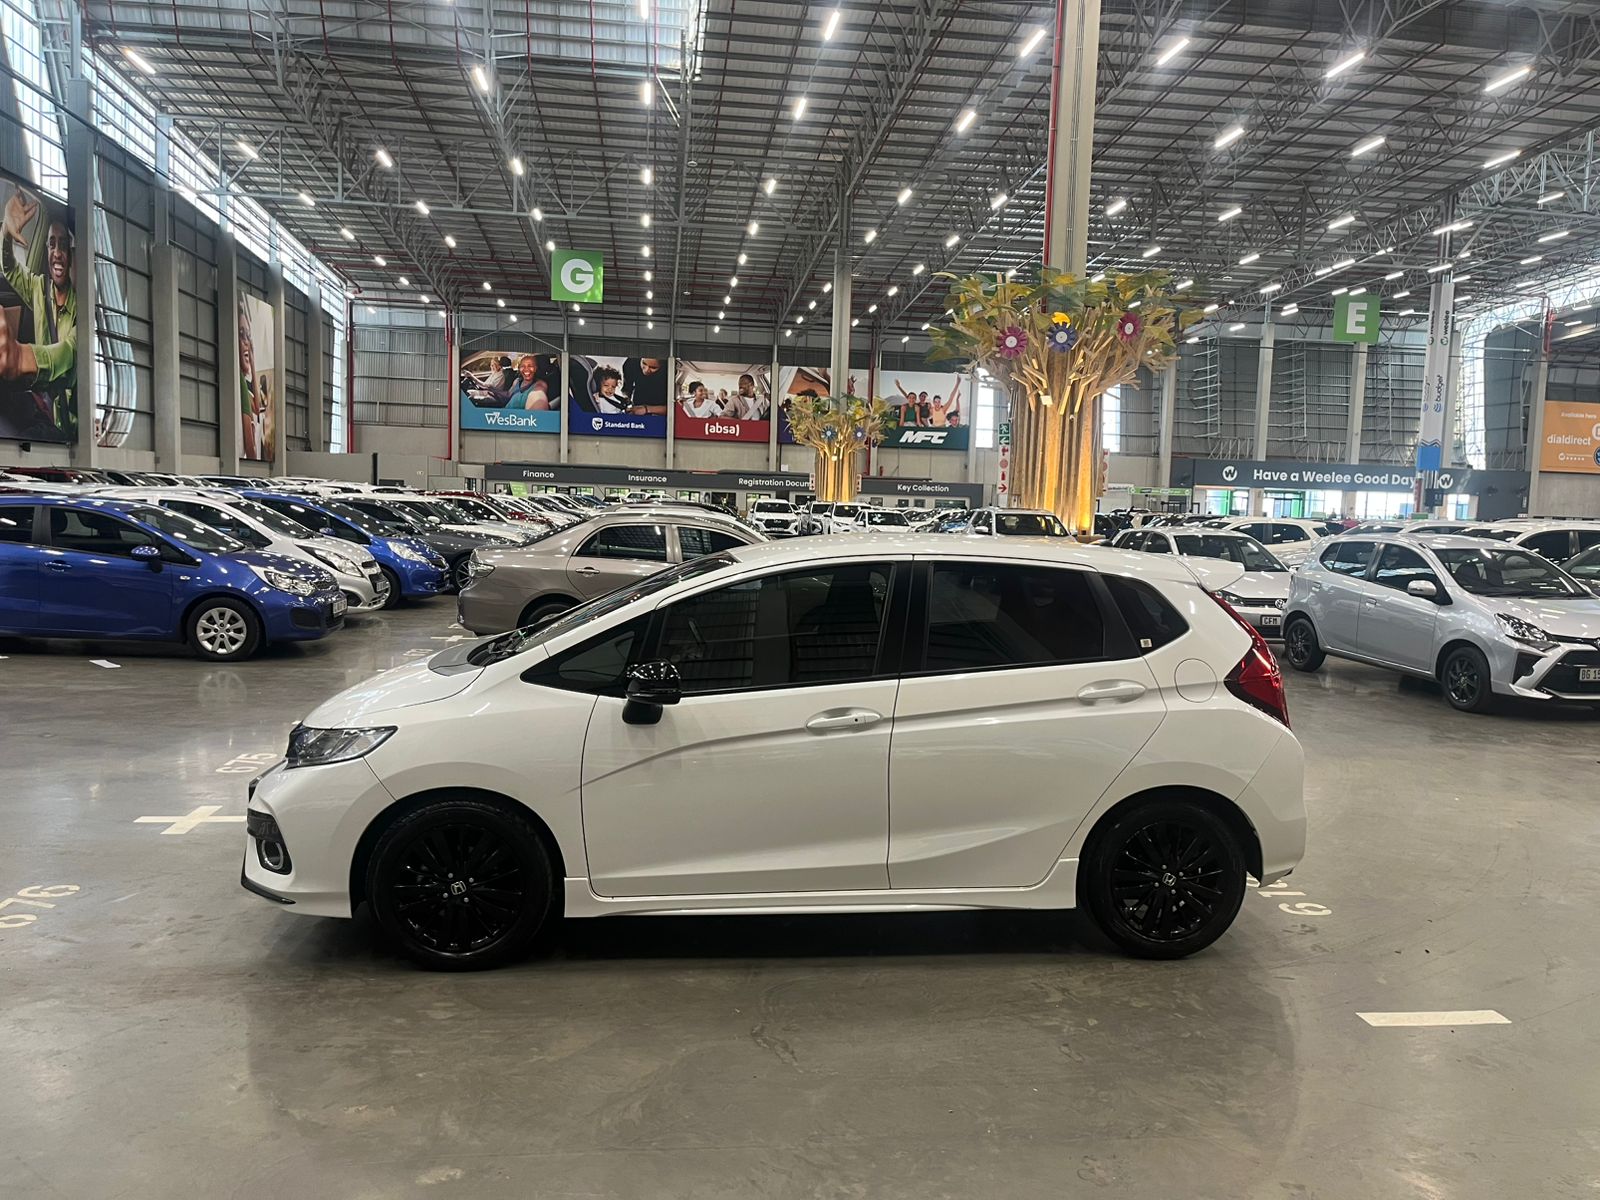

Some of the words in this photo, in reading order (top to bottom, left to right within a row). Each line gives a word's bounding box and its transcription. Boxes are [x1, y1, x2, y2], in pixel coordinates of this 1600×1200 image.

[561, 259, 594, 293] G
[1346, 302, 1368, 335] E
[485, 411, 538, 427] WesBank
[604, 421, 629, 429] Standard
[899, 430, 948, 444] MFC
[1547, 434, 1591, 446] dialdirect
[522, 470, 555, 479] Finance
[628, 474, 667, 483] Insurance
[1253, 469, 1288, 481] Have
[1290, 472, 1299, 482] a
[1302, 471, 1351, 483] Weelee
[1354, 472, 1389, 486] Good
[1391, 474, 1416, 489] Day
[738, 477, 784, 487] Registration
[897, 484, 911, 493] Key
[912, 484, 949, 493] Collection
[215, 753, 278, 773] 675
